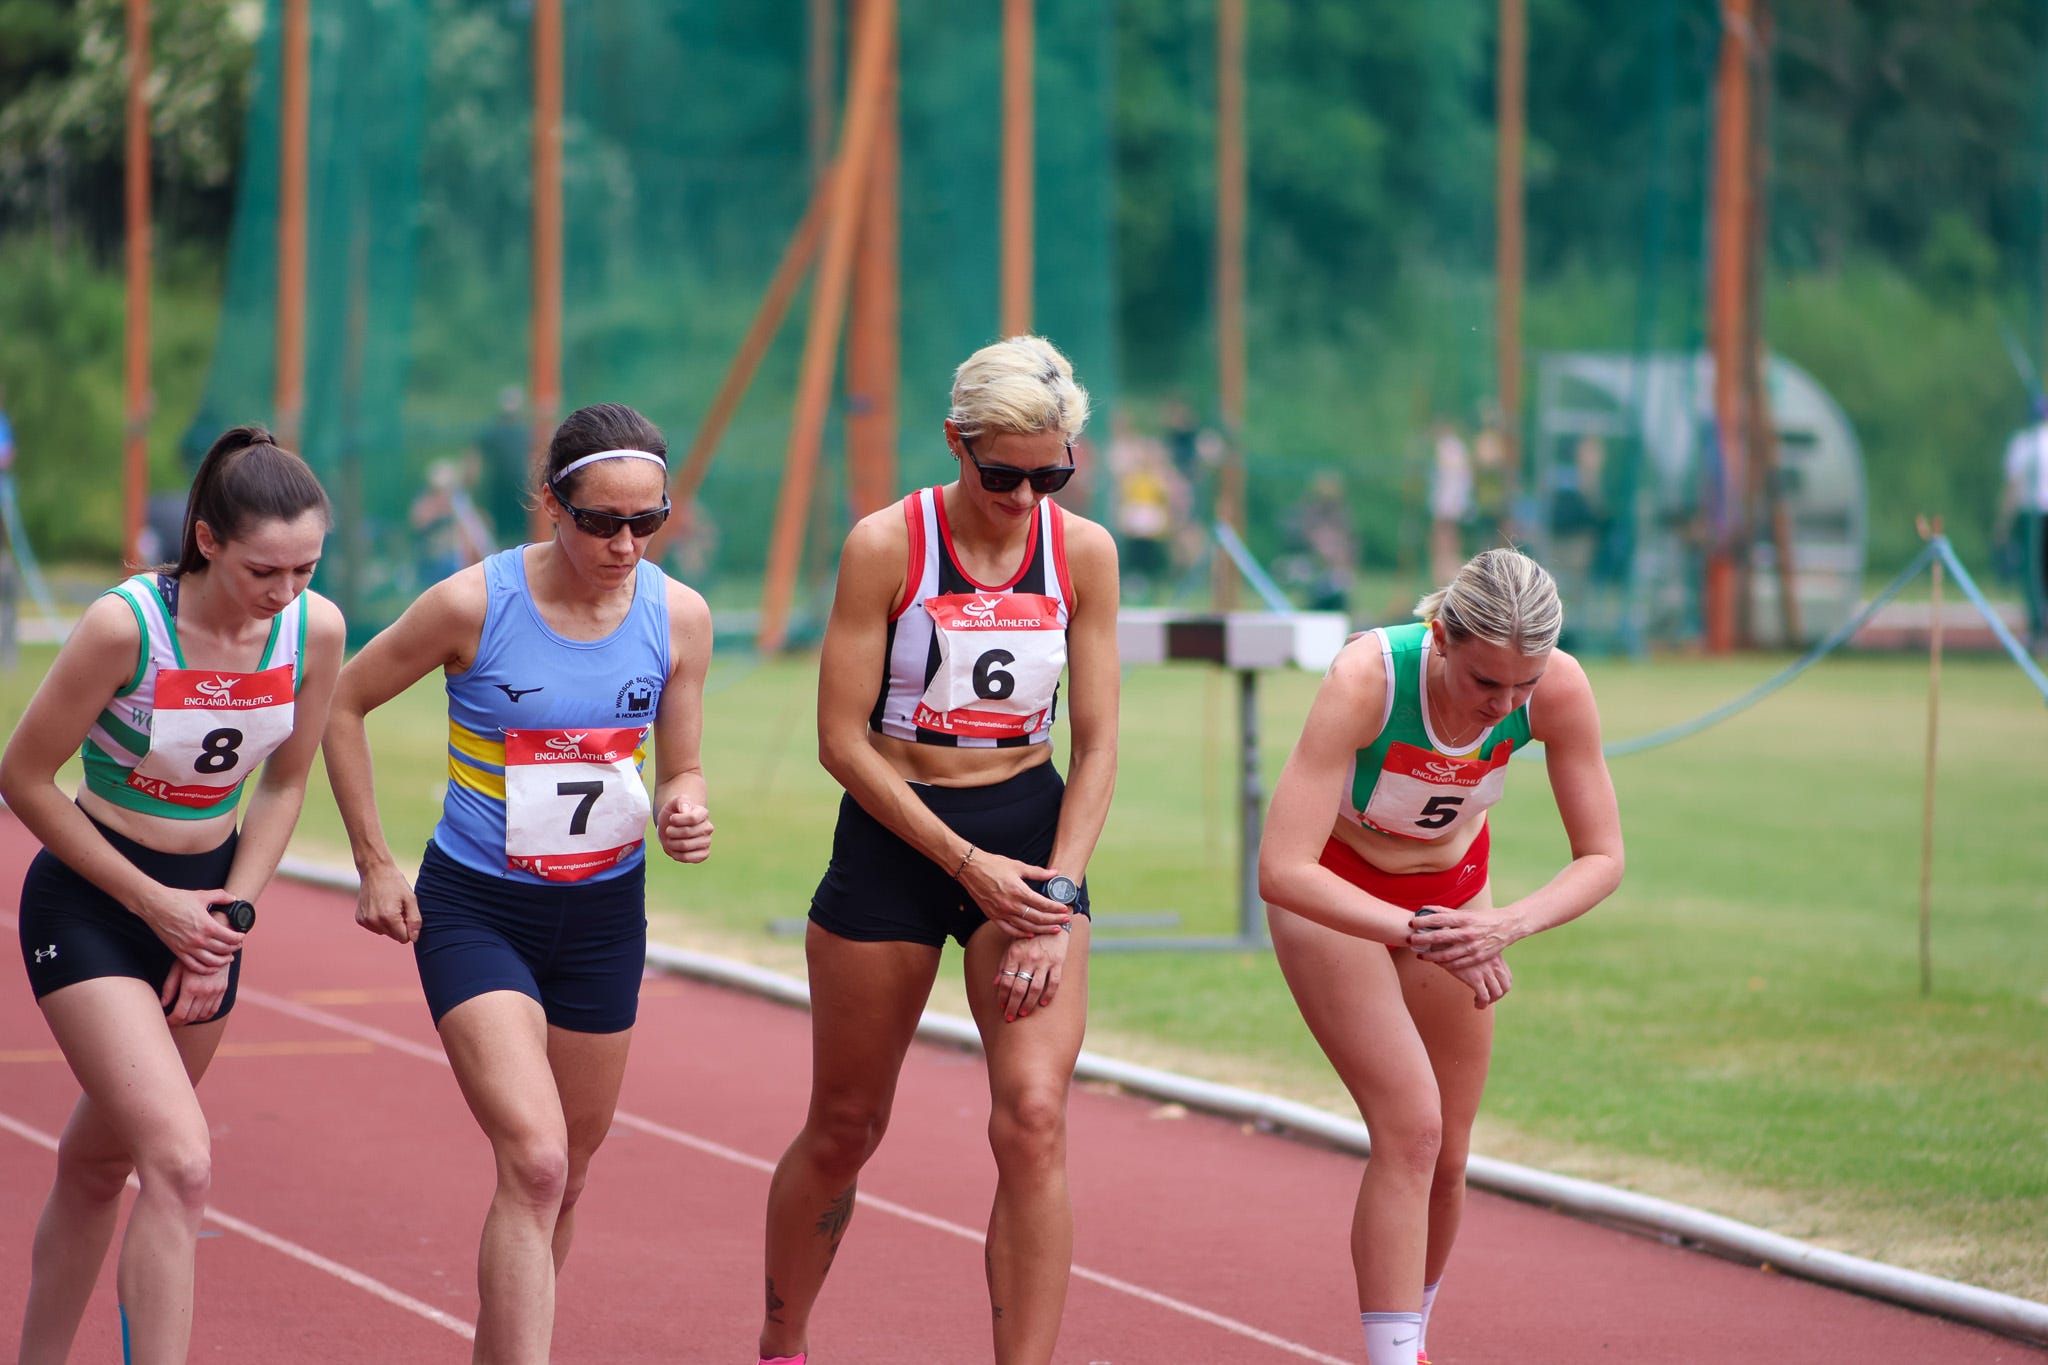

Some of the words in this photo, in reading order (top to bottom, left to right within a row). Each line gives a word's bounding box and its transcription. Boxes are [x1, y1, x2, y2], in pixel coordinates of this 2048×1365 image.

[952, 619, 992, 628] ENGLAND
[997, 619, 1040, 628] ATHLETICS
[973, 649, 1015, 700] 6
[184, 697, 227, 706] ENGLAND
[230, 695, 273, 706] ATHLETICS
[615, 679, 635, 709] WINDSOR
[194, 728, 243, 774] 8
[534, 752, 576, 760] ENGLAND
[1411, 767, 1452, 783] ENGLAND
[557, 781, 604, 835] 7
[1413, 795, 1465, 829] 5
